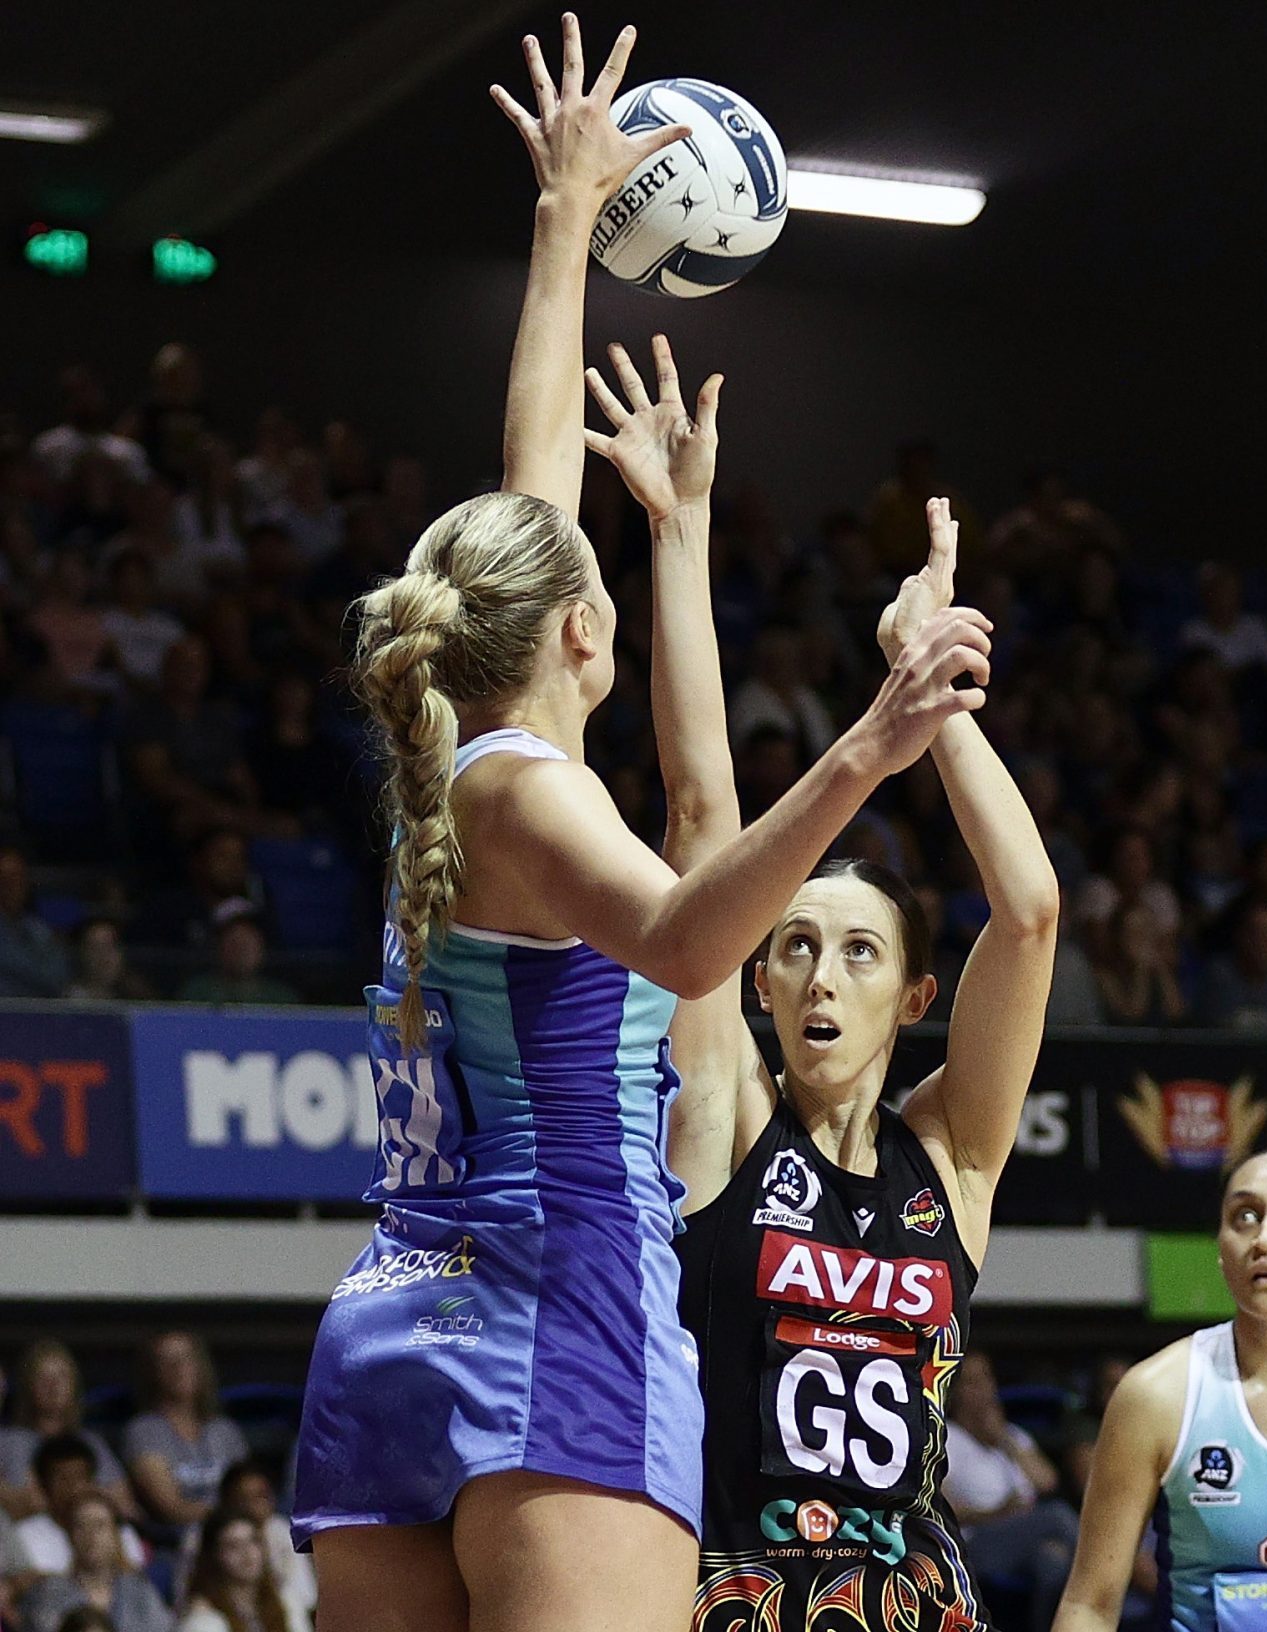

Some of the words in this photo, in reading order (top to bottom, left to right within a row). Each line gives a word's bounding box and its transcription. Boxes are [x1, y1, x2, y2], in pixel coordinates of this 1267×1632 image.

[757, 1211, 811, 1227] PREMIERSHIP
[768, 1244, 934, 1316] AVIS
[413, 1312, 483, 1333] Smith
[813, 1327, 881, 1350] Lodge
[776, 1348, 910, 1489] GS
